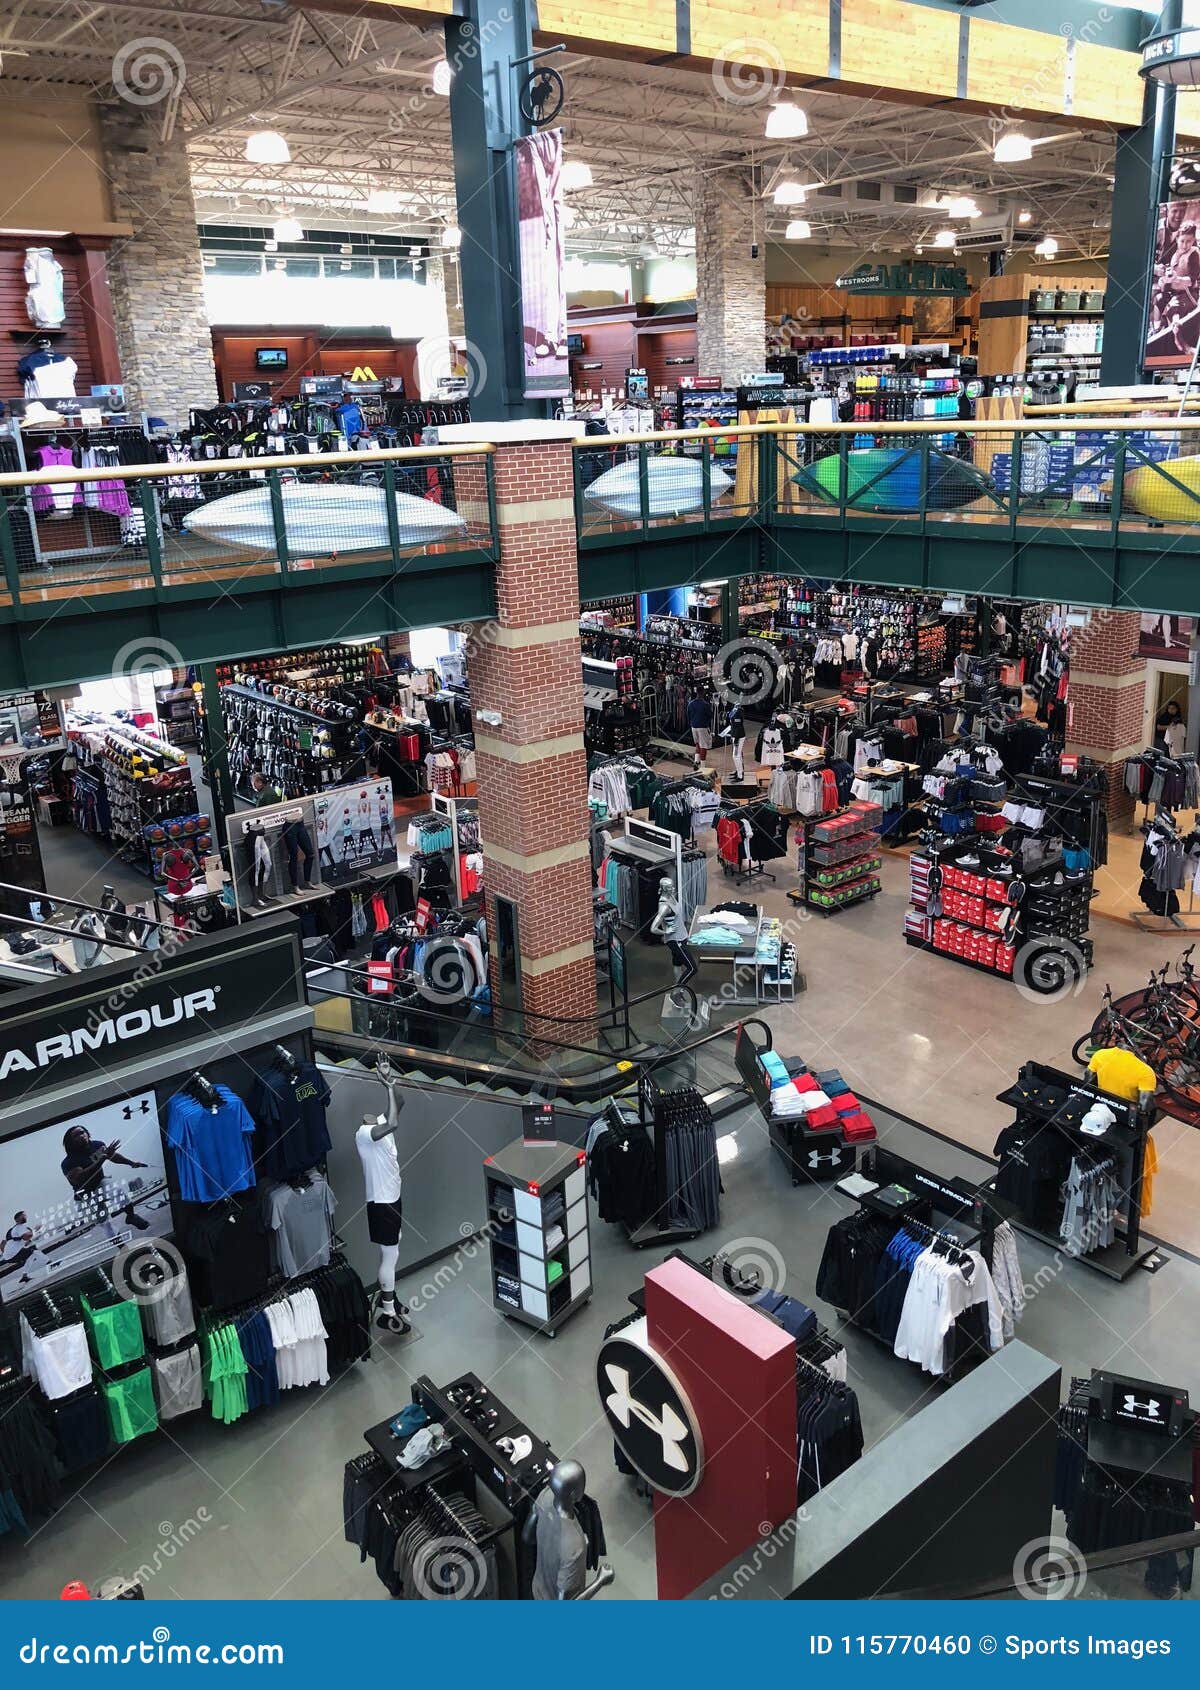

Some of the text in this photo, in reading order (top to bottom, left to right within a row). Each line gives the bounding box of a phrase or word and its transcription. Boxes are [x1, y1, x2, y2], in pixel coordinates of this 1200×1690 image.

[629, 368, 647, 376] PING
[38, 702, 53, 712] 72
[3, 807, 30, 818] REAM
[6, 814, 31, 824] GGER
[1070, 1085, 1128, 1112] UNDER ARMOUR
[915, 1173, 974, 1207] UNDER ARMOUR
